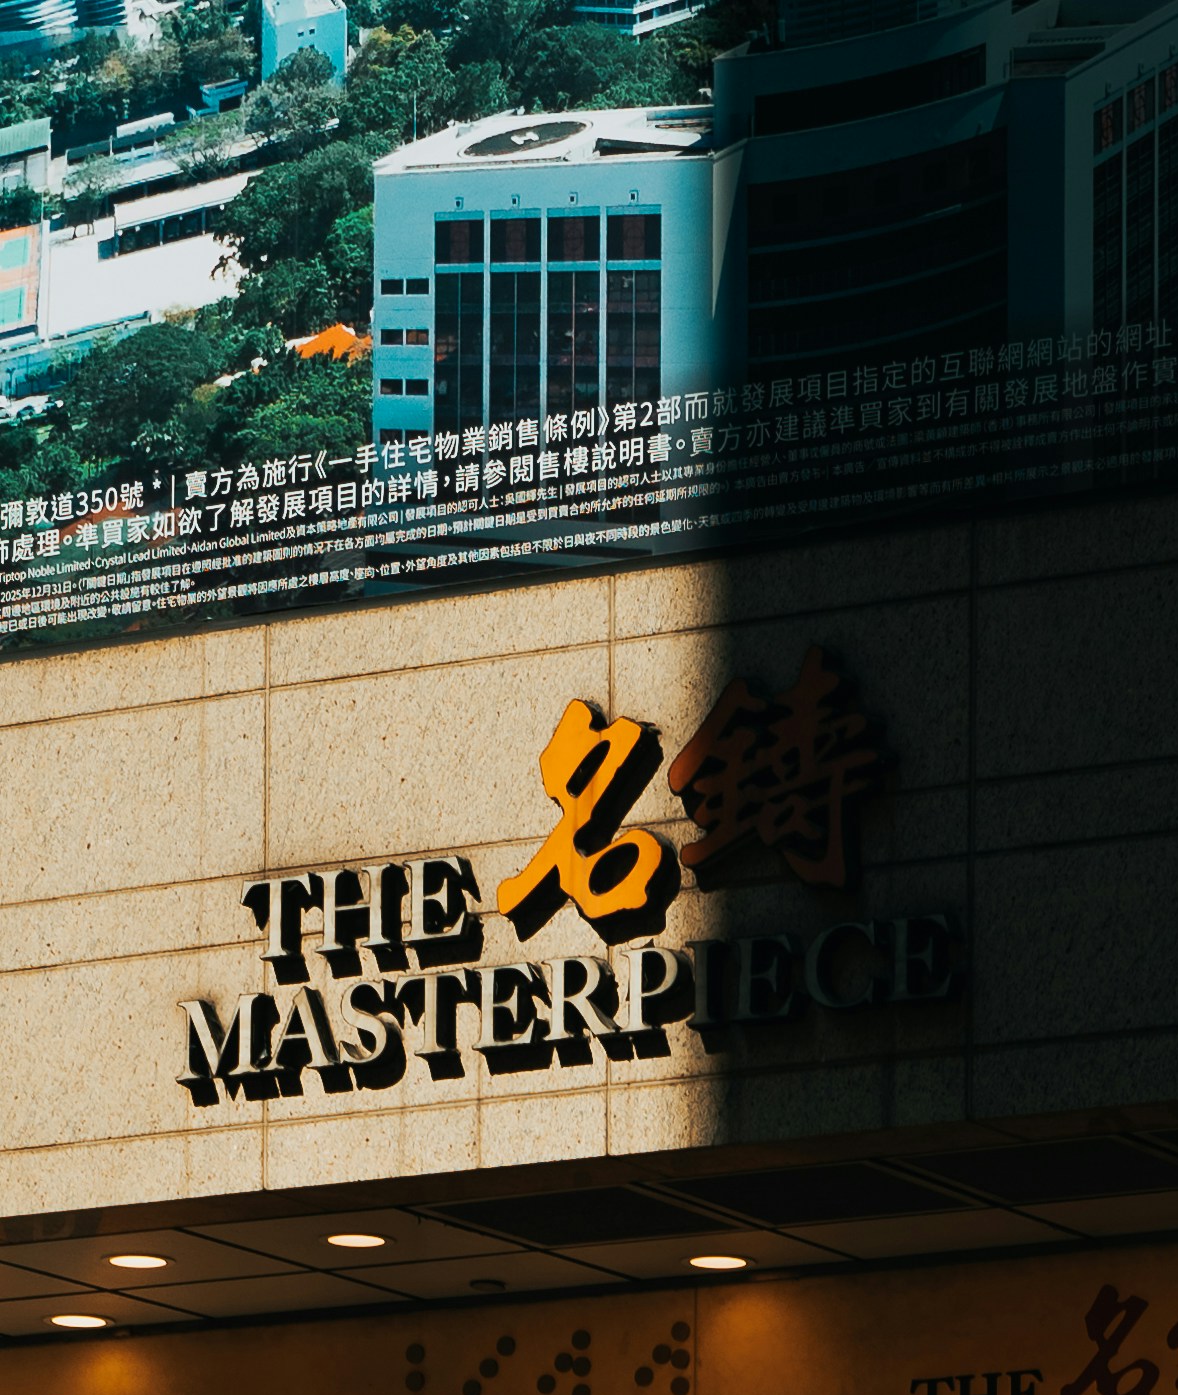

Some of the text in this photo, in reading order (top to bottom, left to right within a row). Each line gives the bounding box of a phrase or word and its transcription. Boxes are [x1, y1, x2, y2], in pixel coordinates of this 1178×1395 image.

[28, 563, 54, 580] Noble
[128, 549, 150, 564] Lead
[219, 534, 248, 550] Global
[242, 855, 472, 962] THE
[176, 913, 956, 1085] MASTERPIECE
